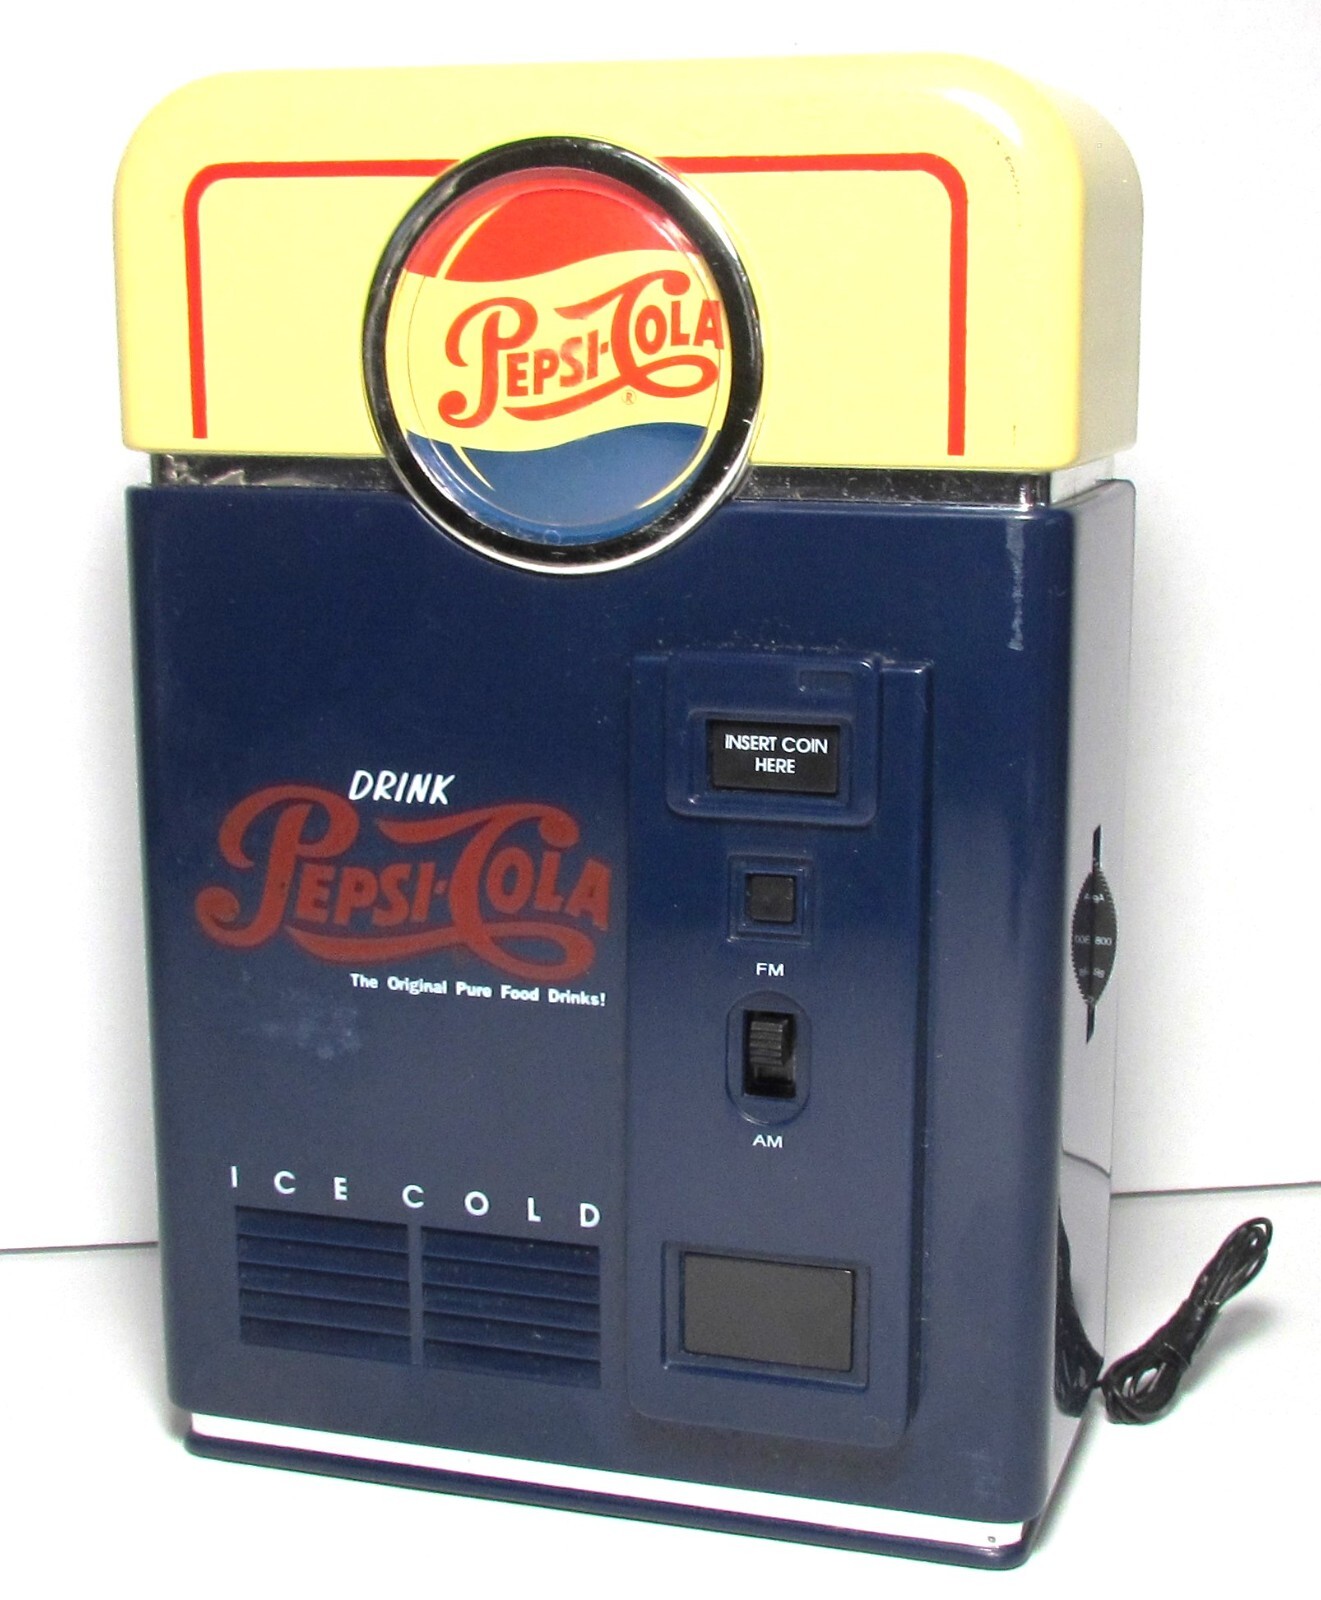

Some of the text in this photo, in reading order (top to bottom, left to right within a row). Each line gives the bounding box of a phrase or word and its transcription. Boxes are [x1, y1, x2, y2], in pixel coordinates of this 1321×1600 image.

[724, 733, 828, 754] INSERT COIN
[755, 757, 796, 774] HERE
[348, 769, 456, 805] DRINK
[756, 963, 785, 977] FM
[349, 972, 607, 1007] The Original Pure Food Drinks!
[751, 1134, 783, 1149] AM
[230, 1165, 602, 1228] ICE COLD
